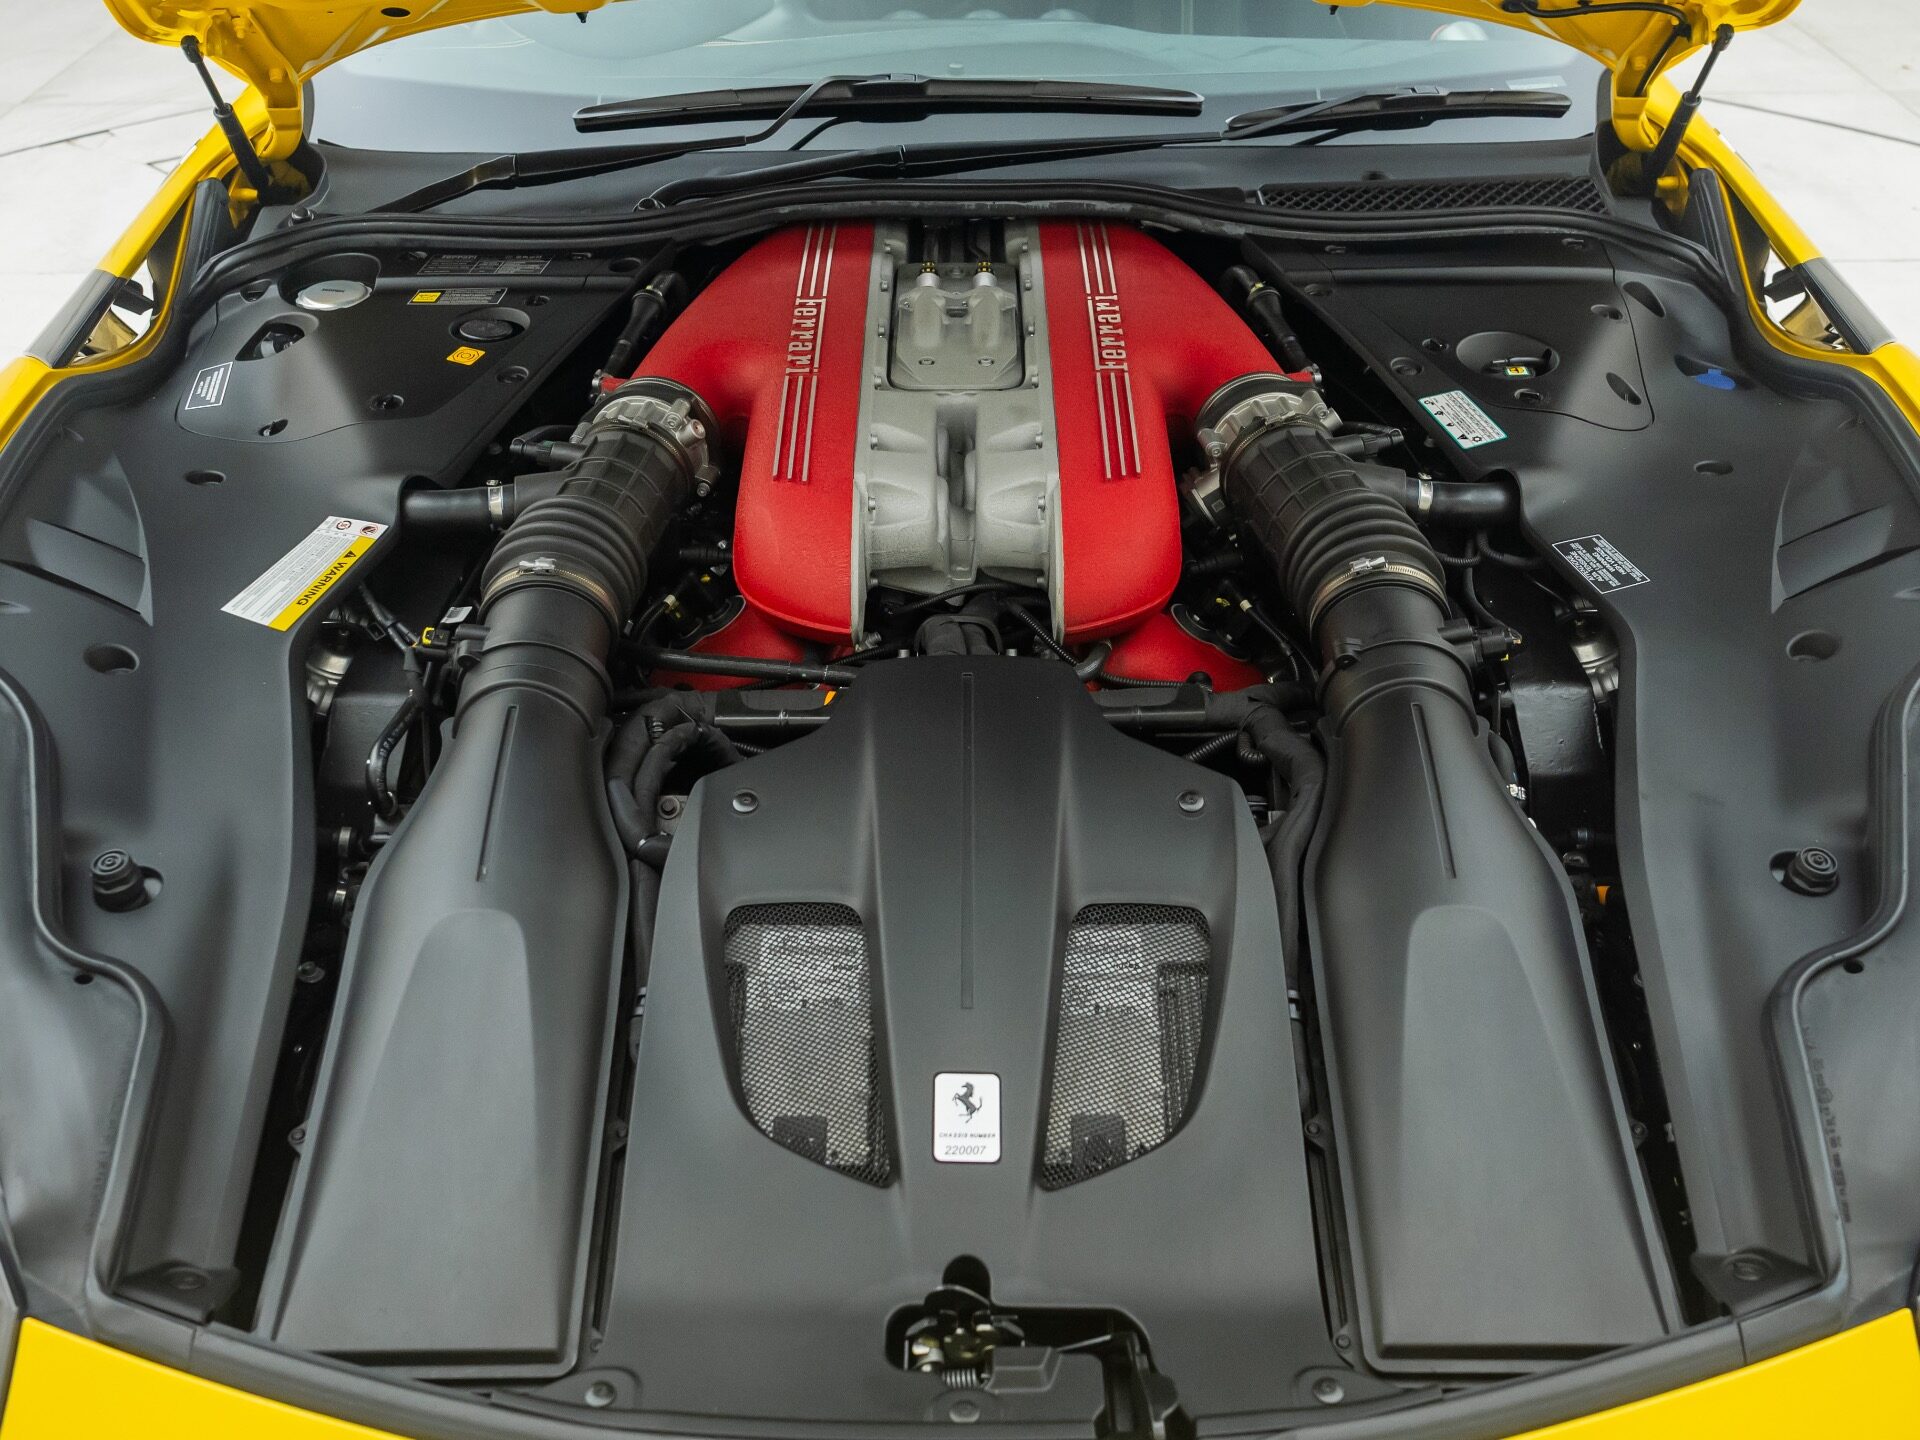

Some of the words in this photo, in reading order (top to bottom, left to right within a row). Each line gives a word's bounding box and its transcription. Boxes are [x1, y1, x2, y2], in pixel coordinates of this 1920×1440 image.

[785, 297, 827, 374] Ferrari
[1086, 294, 1128, 372] Ferrari
[295, 561, 347, 606] WARNING
[944, 1145, 987, 1156] 220007
